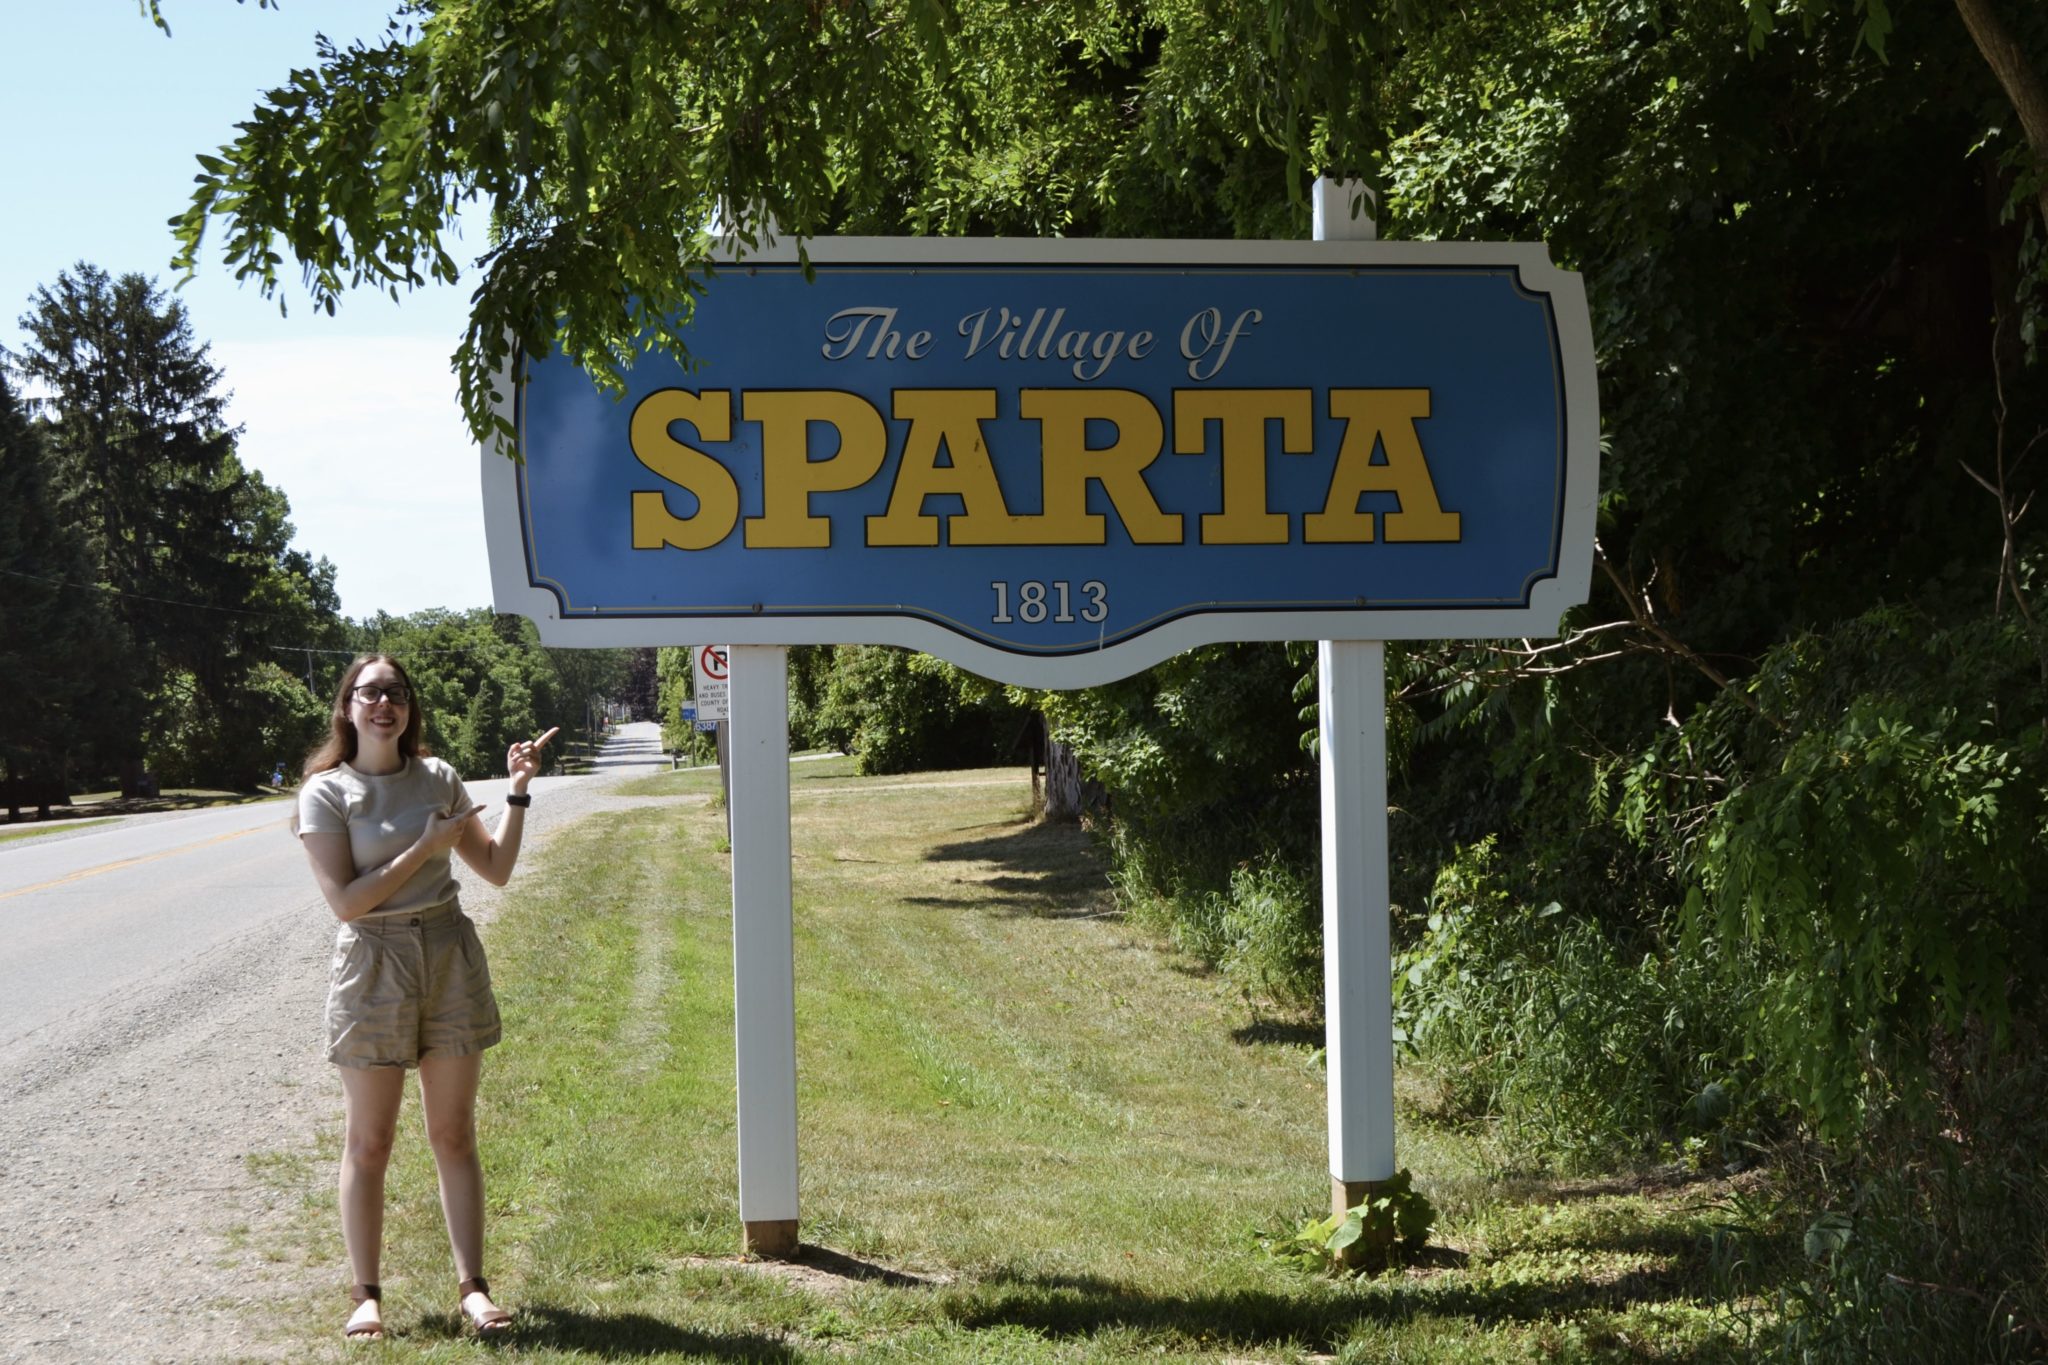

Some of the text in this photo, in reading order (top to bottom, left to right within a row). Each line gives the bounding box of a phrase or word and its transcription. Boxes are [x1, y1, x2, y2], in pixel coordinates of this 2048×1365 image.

[822, 306, 1263, 382] The Village Of
[629, 387, 1462, 551] SPARTA
[991, 580, 1109, 624] 1813
